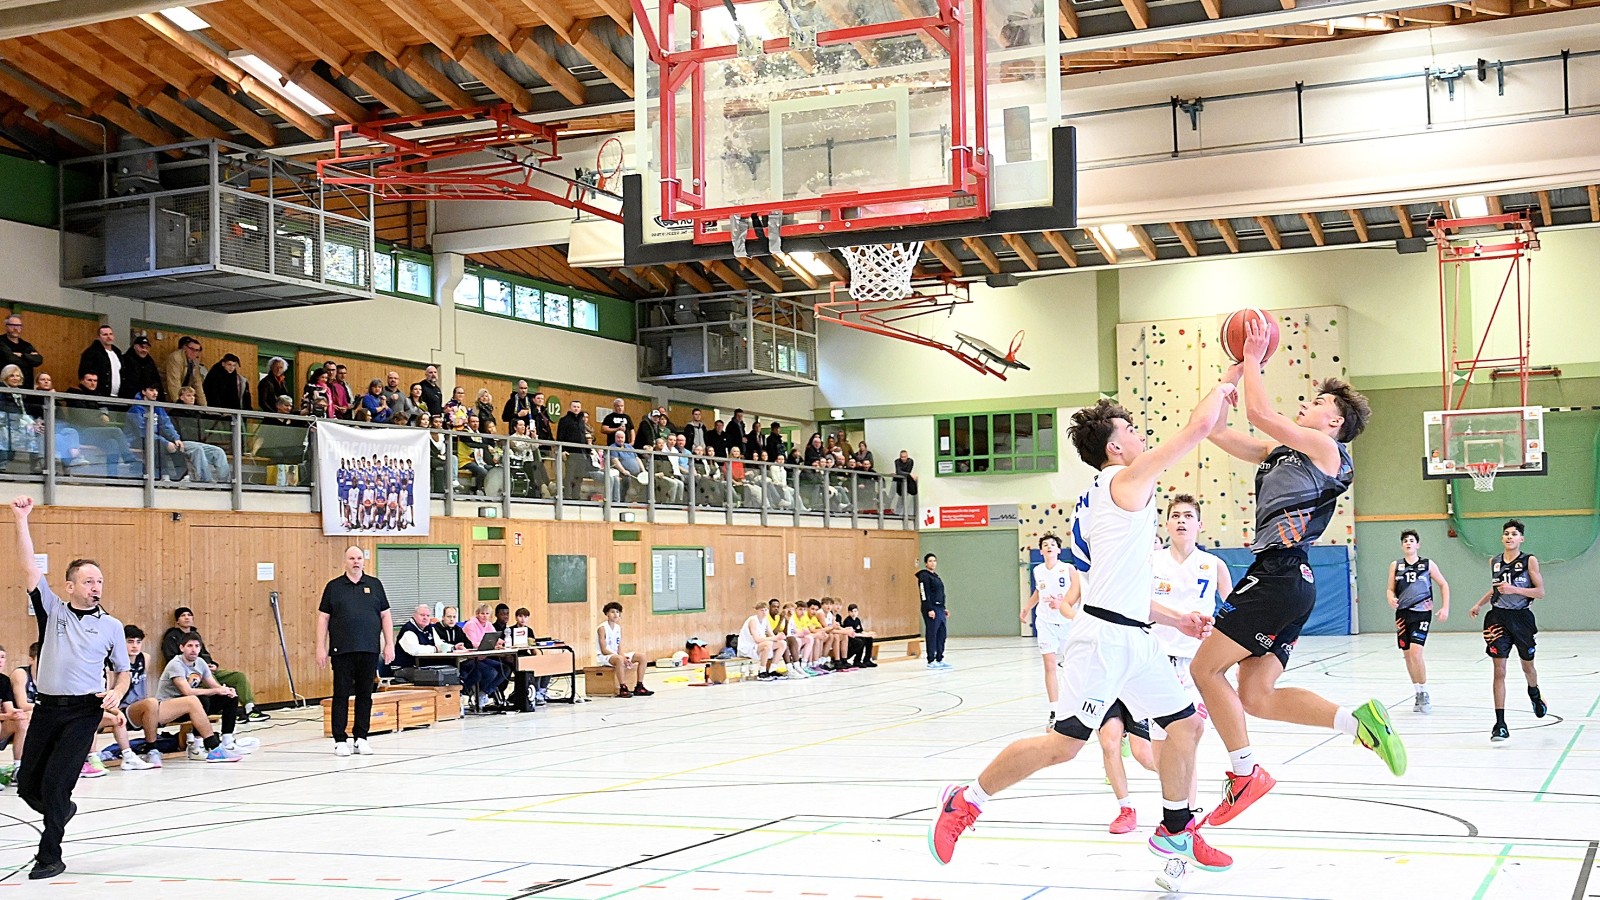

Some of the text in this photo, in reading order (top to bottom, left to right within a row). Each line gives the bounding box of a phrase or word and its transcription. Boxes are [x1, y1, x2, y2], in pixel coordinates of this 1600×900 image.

[548, 402, 560, 415] U2
[326, 439, 380, 461] PHOENIX
[1059, 577, 1065, 587] 9
[1405, 572, 1417, 582] 13
[1502, 572, 1512, 584] 11
[1197, 578, 1210, 598] 7
[1236, 575, 1259, 594] 7
[1419, 621, 1429, 631] 13
